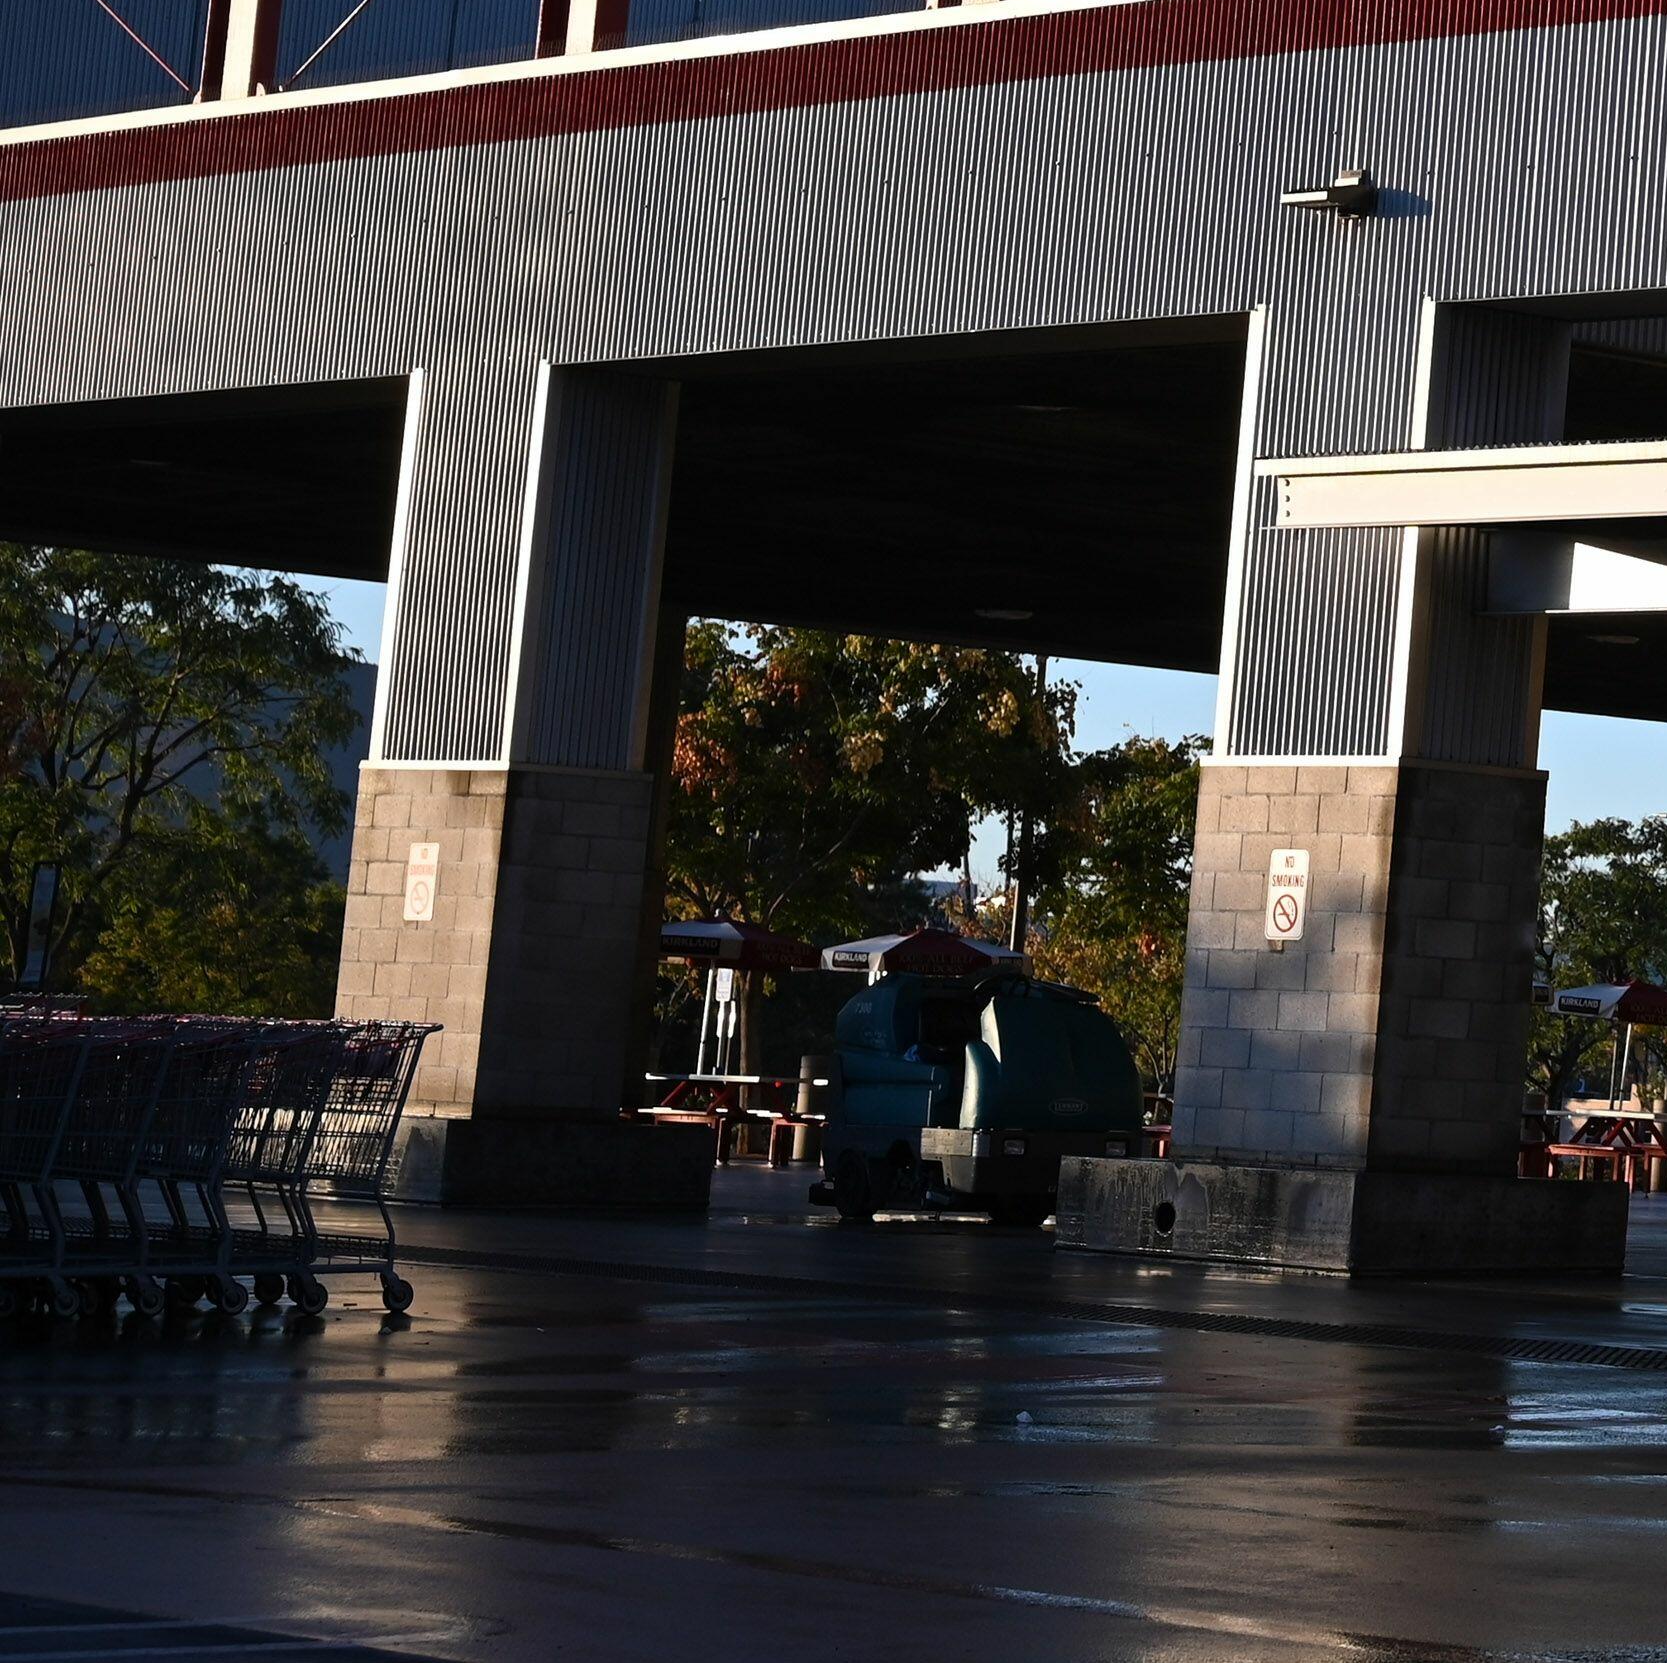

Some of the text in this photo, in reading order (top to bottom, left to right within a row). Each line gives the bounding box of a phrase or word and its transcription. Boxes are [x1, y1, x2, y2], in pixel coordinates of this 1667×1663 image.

[1285, 855, 1295, 868] NO
[1272, 874, 1304, 887] SMOKING
[662, 936, 718, 949] KIRKLAND
[834, 952, 868, 963] KIRKLAND
[1560, 997, 1600, 1009] KIRKLAND
